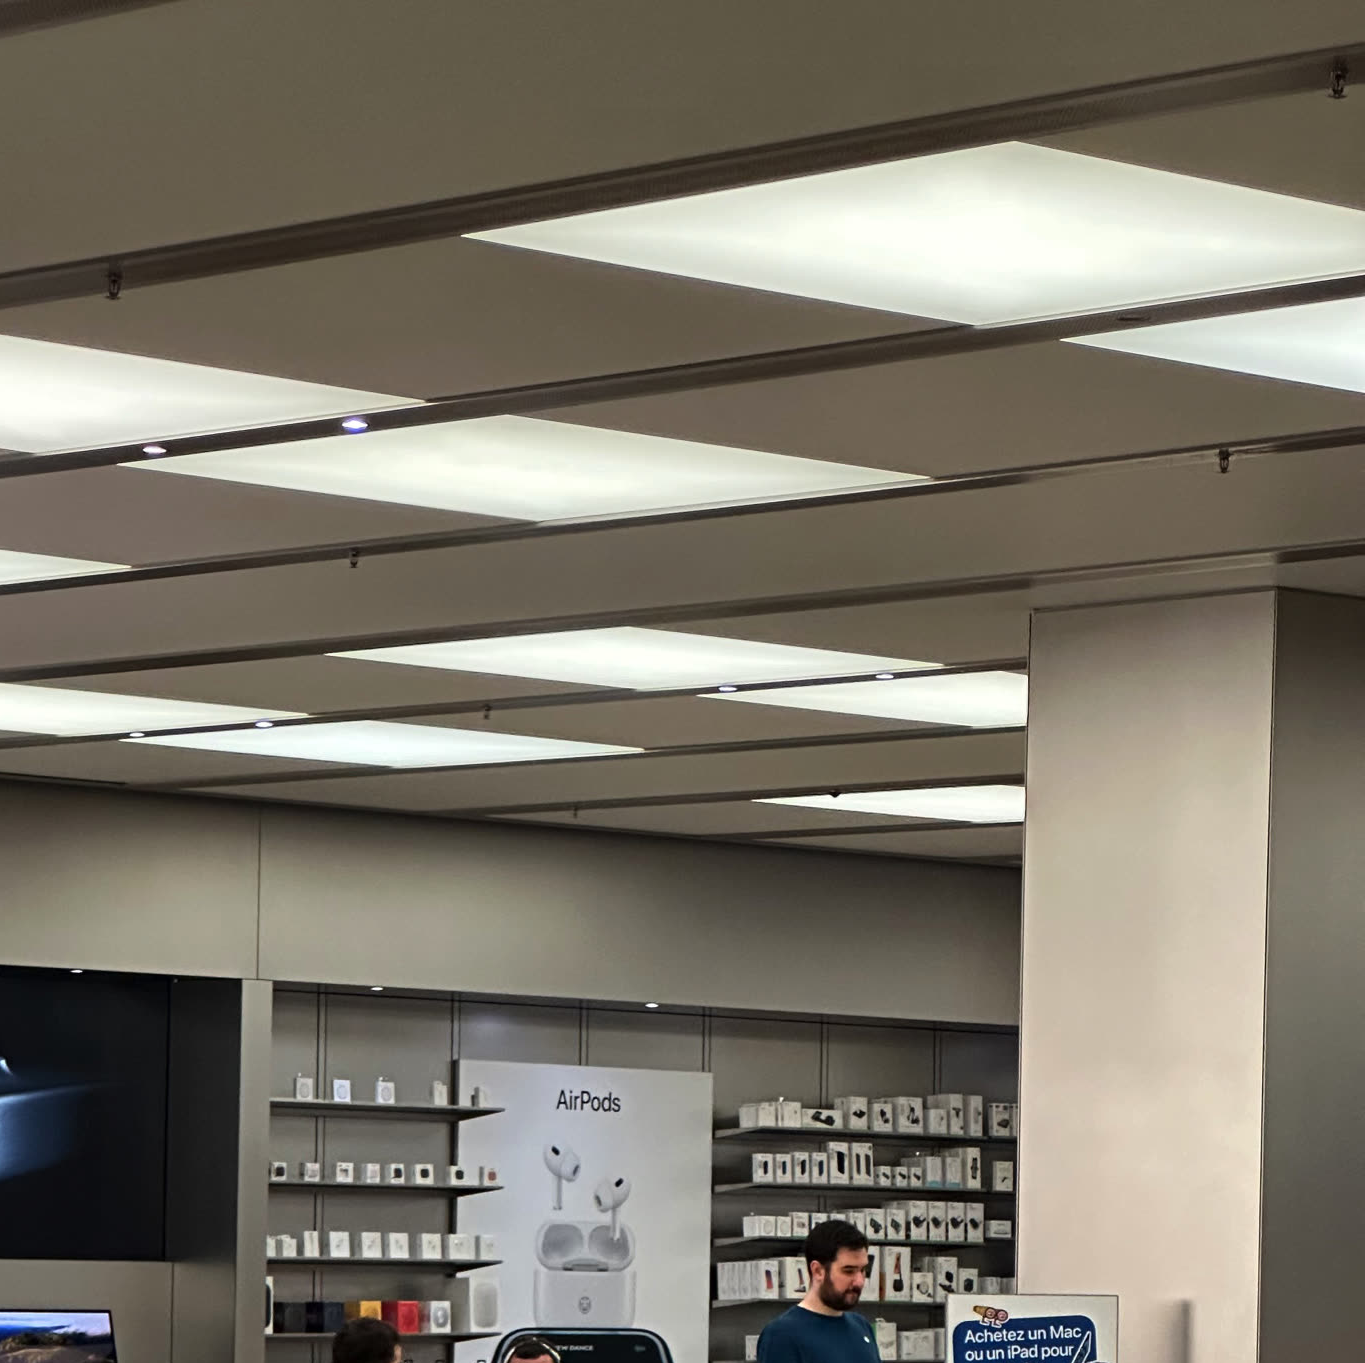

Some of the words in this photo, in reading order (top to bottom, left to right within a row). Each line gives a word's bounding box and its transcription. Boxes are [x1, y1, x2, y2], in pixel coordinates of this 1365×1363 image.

[556, 1089, 621, 1113] AirPods
[964, 1329, 1025, 1344] Achetez
[1028, 1329, 1047, 1340] un
[1049, 1325, 1082, 1339] Mac
[964, 1350, 984, 1362] ou
[986, 1349, 1005, 1360] un
[1007, 1344, 1038, 1360] iPad
[1041, 1345, 1074, 1360] pour
